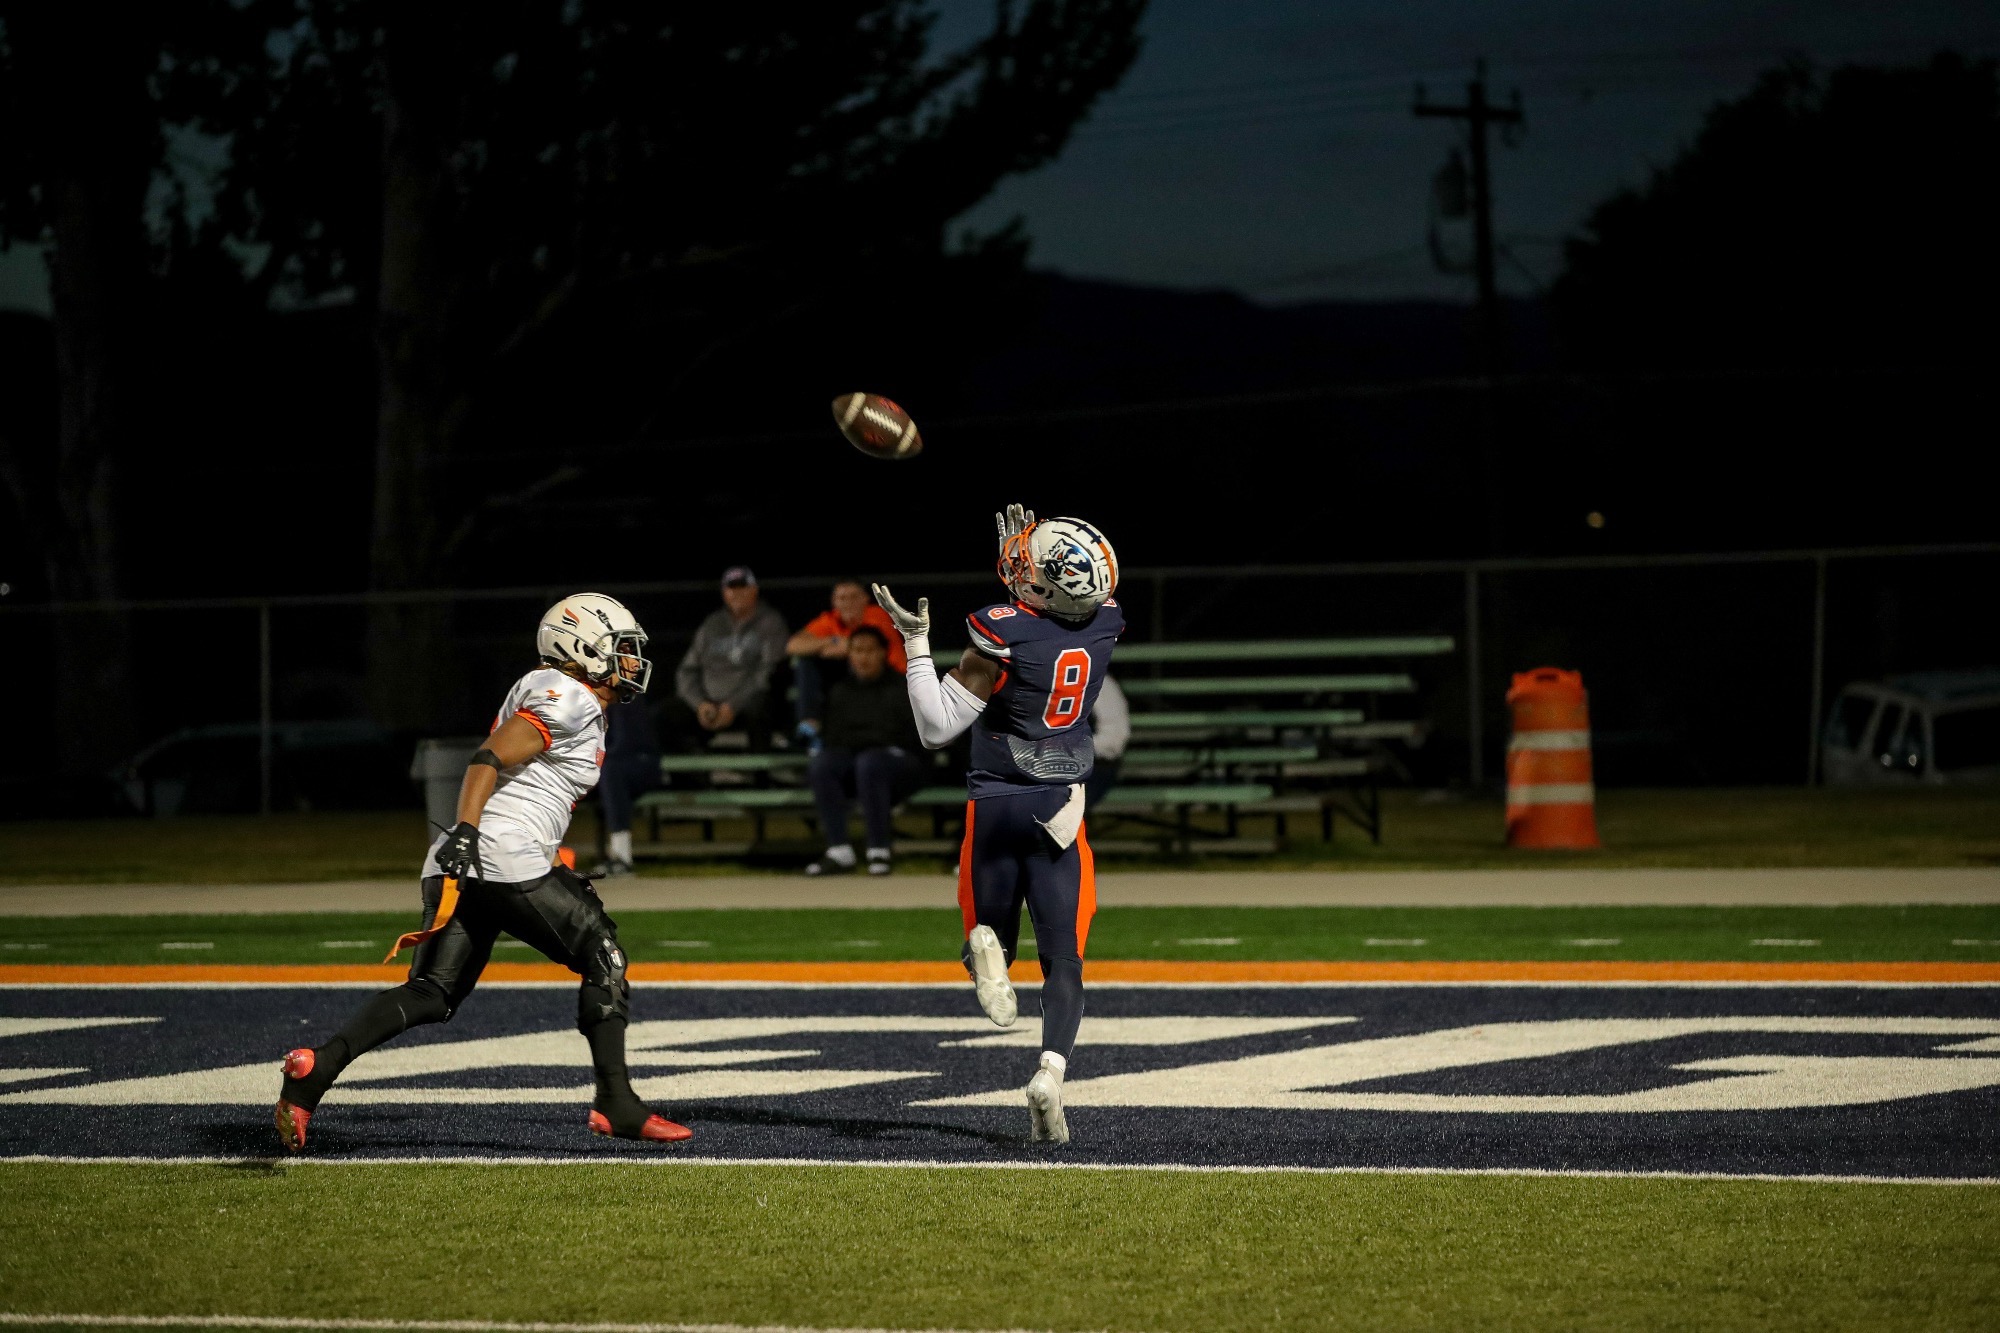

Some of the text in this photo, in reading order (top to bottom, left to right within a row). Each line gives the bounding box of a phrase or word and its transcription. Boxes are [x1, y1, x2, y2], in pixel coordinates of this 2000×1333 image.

[988, 607, 1017, 620] 8
[1042, 648, 1092, 729] 8
[0, 1013, 2000, 1113] EG
